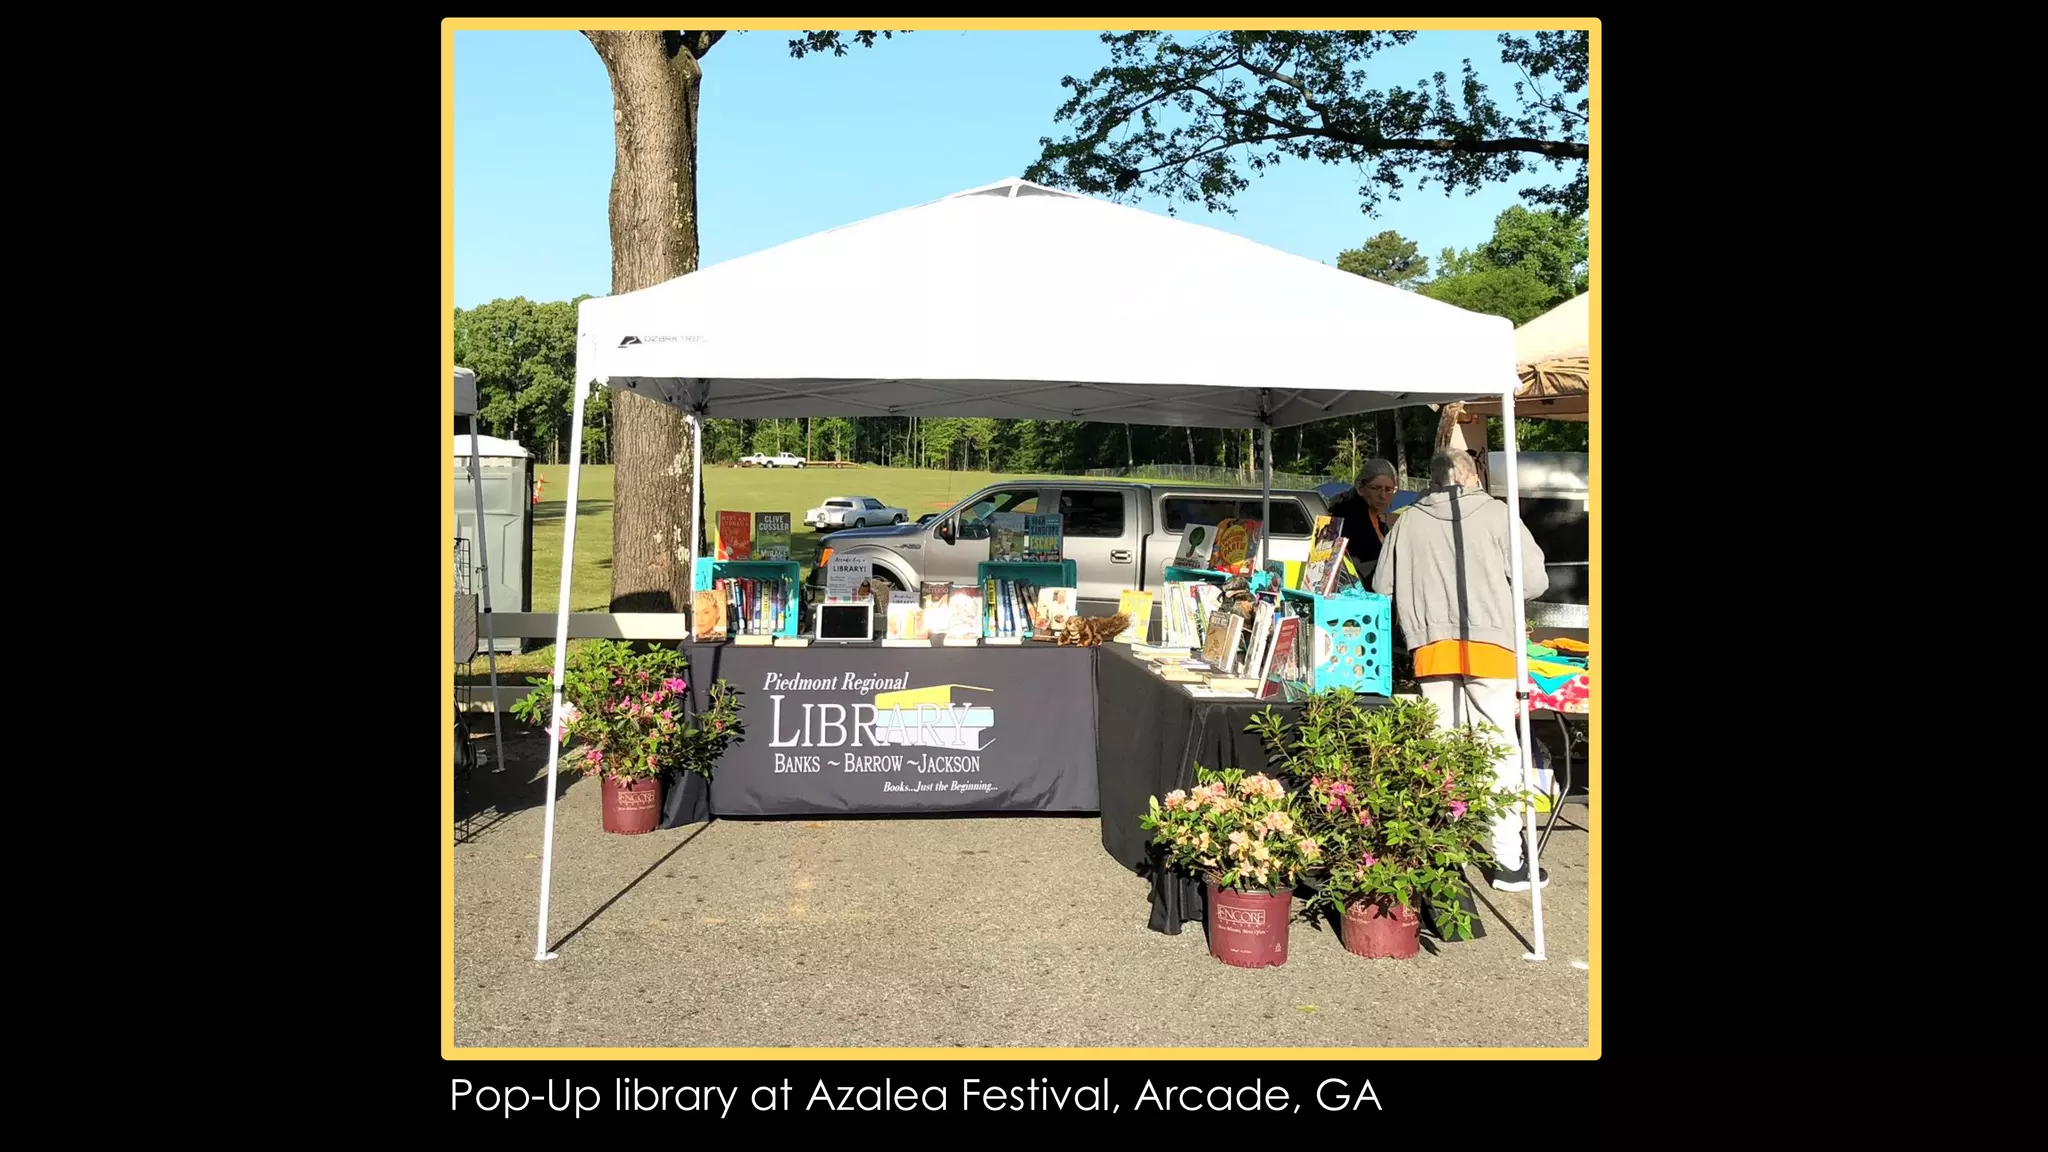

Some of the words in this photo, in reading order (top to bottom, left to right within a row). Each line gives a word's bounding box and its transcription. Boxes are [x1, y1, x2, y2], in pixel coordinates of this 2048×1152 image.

[764, 515, 784, 523] CLIVE
[759, 523, 789, 531] CUSSLER
[760, 549, 787, 558] MIRAGE
[833, 565, 867, 573] LIBRARY!
[763, 672, 838, 691] Piedmont
[841, 672, 909, 695] Regional
[768, 695, 973, 747] LIBRARY
[774, 753, 821, 773] BANKS
[844, 753, 903, 773] BARROW
[935, 780, 949, 792] the
[950, 780, 999, 794] Beginning...
[618, 792, 654, 802] ENCORE
[1219, 907, 1264, 924] ENCORE
